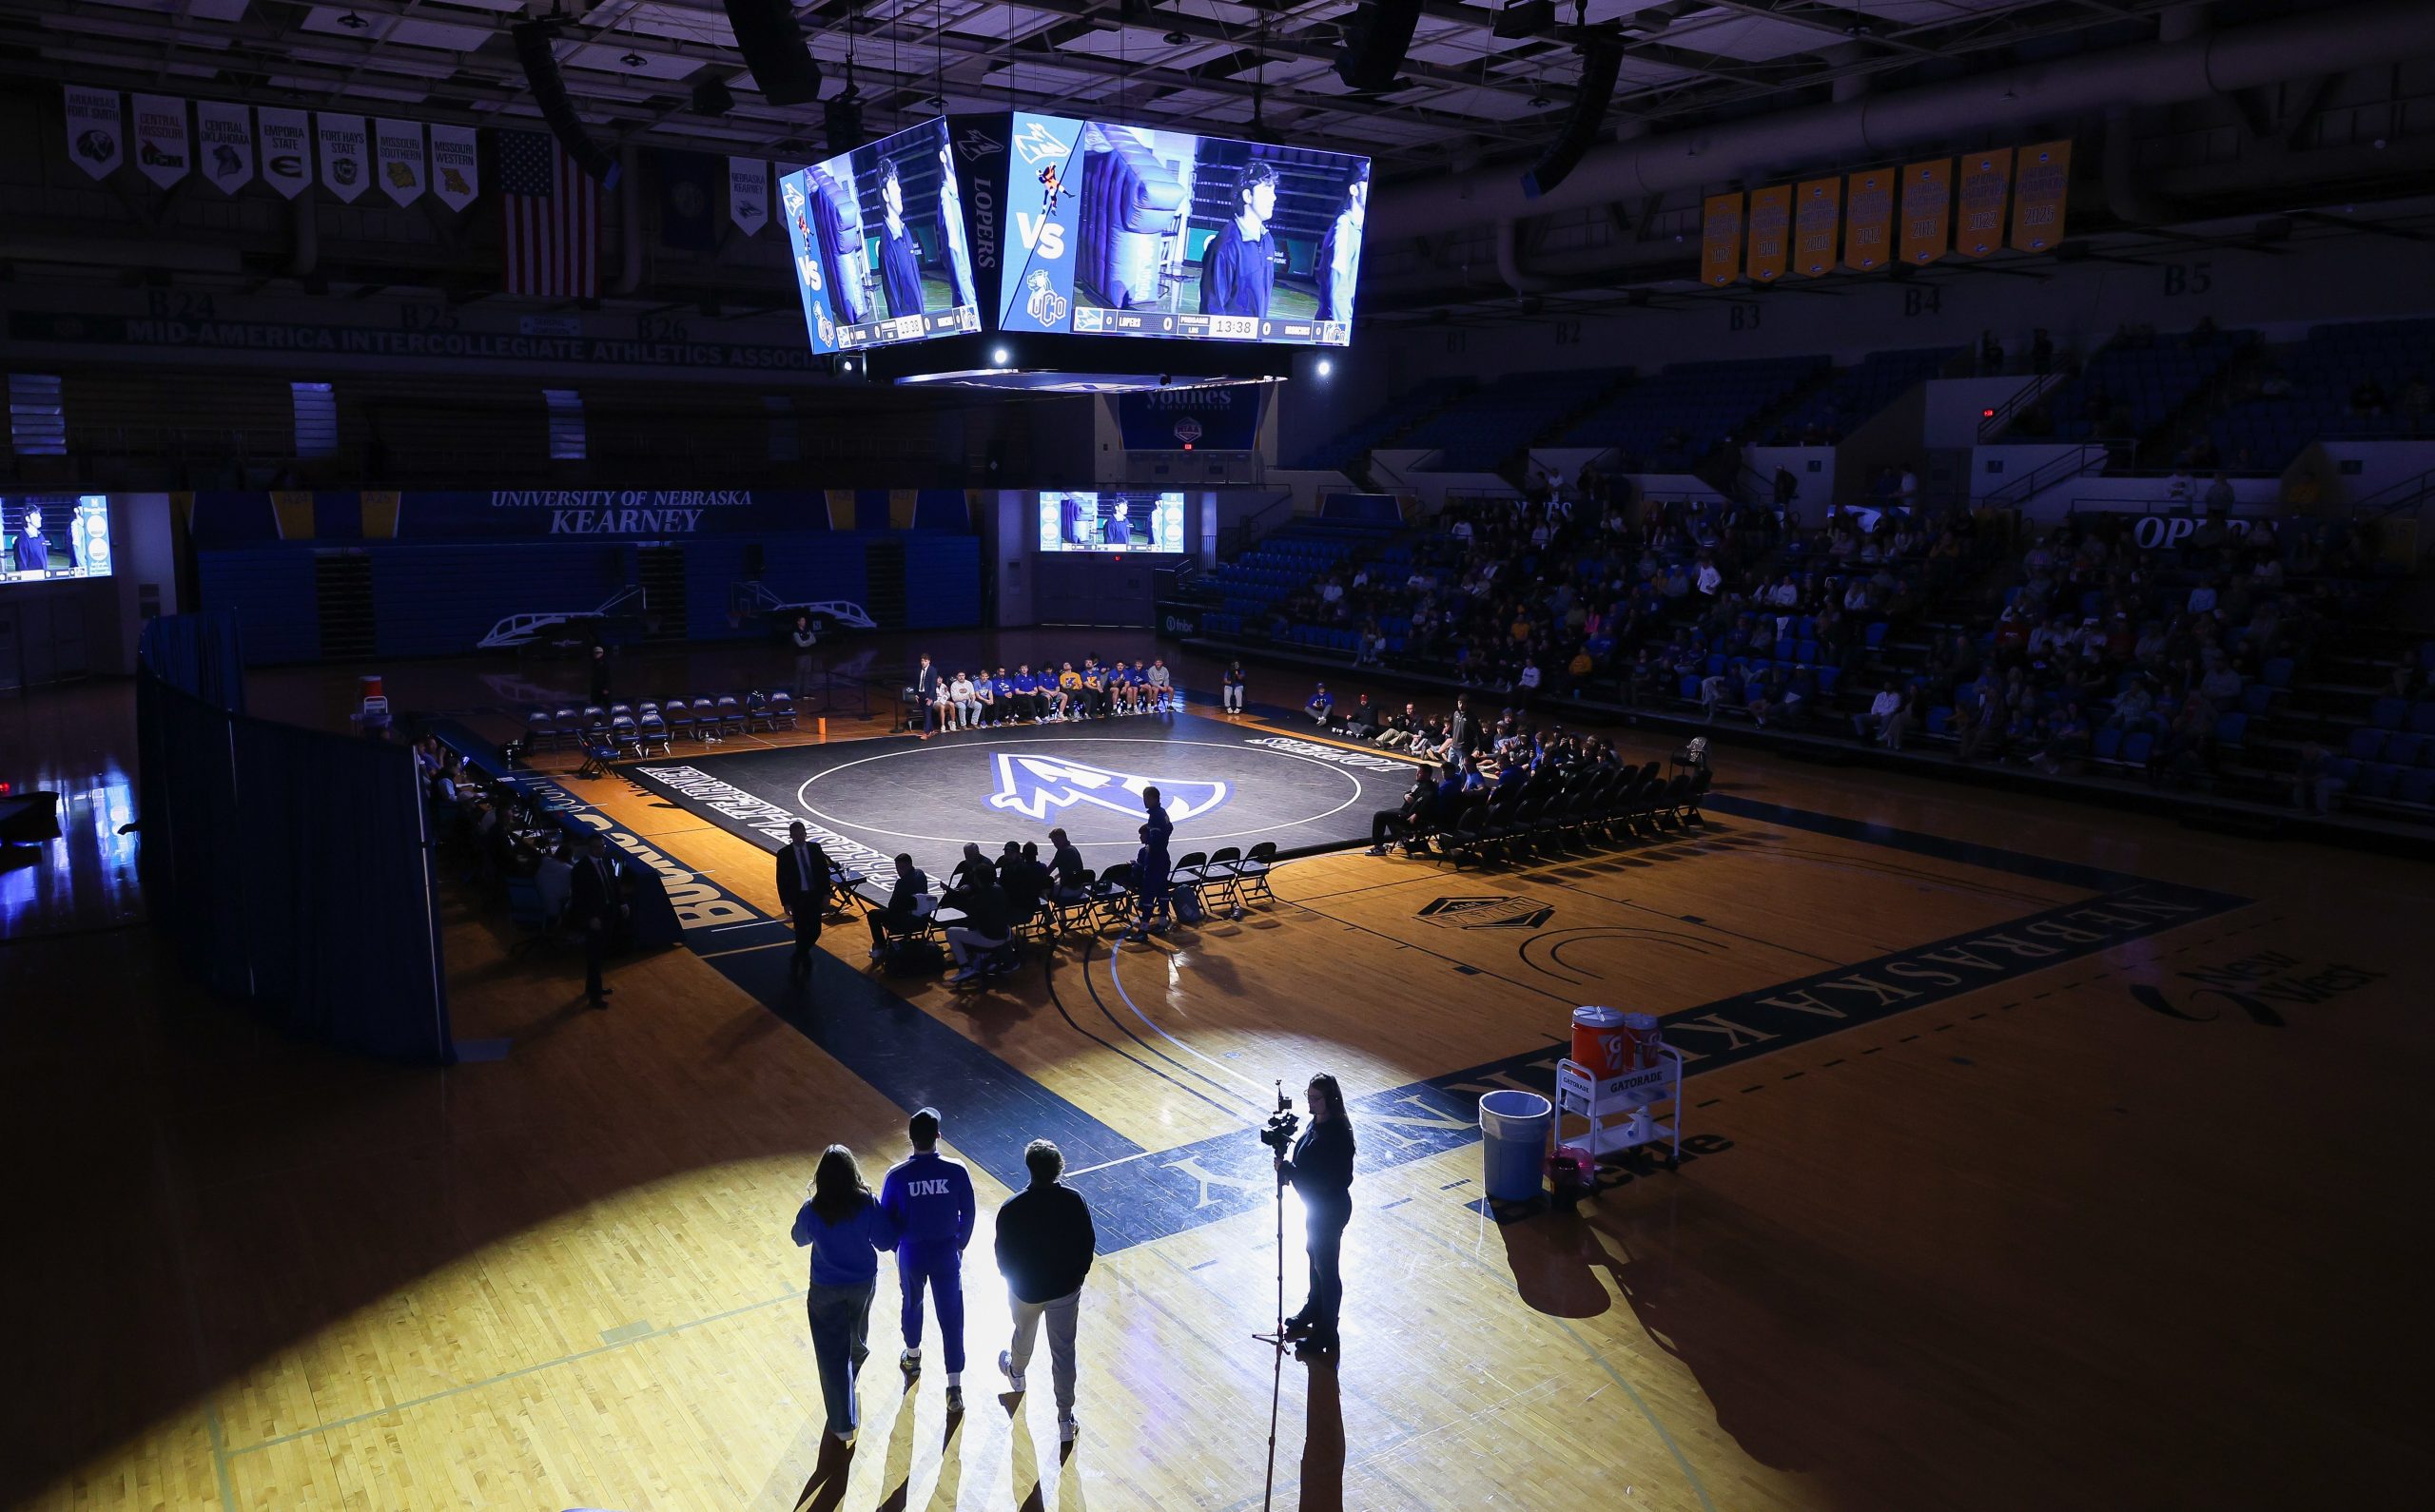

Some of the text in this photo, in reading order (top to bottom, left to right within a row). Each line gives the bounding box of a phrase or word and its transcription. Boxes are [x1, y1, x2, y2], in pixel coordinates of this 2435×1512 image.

[68, 94, 117, 109] ARKANSAS
[67, 105, 119, 122] FORT SMITH
[139, 113, 181, 126] CENTRAL
[138, 125, 185, 139] MISSOURI
[205, 120, 244, 134] CENTRAL
[263, 125, 305, 139] EMPORIA
[201, 131, 250, 145] OKLAHOMA
[272, 138, 299, 150] STATE
[321, 129, 365, 144] FORT HAYS
[380, 136, 420, 149] MISSOURI
[332, 144, 356, 155] STATE
[380, 147, 422, 161] SOUTHERN
[434, 141, 475, 154] MISSOURI
[435, 151, 475, 166] WESTERN
[730, 172, 766, 185] NEBRASKA
[733, 183, 765, 195] KEARNEY
[973, 175, 997, 270] LOPERS
[1015, 211, 1065, 260] VS
[797, 255, 823, 292] VS
[2162, 262, 2212, 298] B5
[148, 290, 216, 319] B24
[1031, 291, 1066, 327] UCO
[1903, 287, 1942, 318] B4
[401, 304, 459, 330] B25
[1162, 317, 1173, 331] 0
[1729, 303, 1762, 331] B3
[638, 318, 688, 341] B26
[1216, 320, 1252, 333] 13:38
[1262, 321, 1272, 336] 0
[1555, 320, 1581, 345] B2
[124, 319, 336, 350] MID-AMERICA
[341, 329, 585, 360] INTERCOLLEGIATE
[593, 341, 724, 366] ATHLETICS
[491, 490, 752, 508] UNIVERSITY OF NEBRASKA
[549, 509, 705, 534] KEARNEY
[1753, 893, 2201, 1021] NEBRASKA
[2174, 950, 2302, 989] New
[2243, 961, 2389, 1005] West
[1562, 1076, 1590, 1095] GATORADE
[1609, 1070, 1664, 1095] GATORADE
[907, 1177, 950, 1198] UNK
